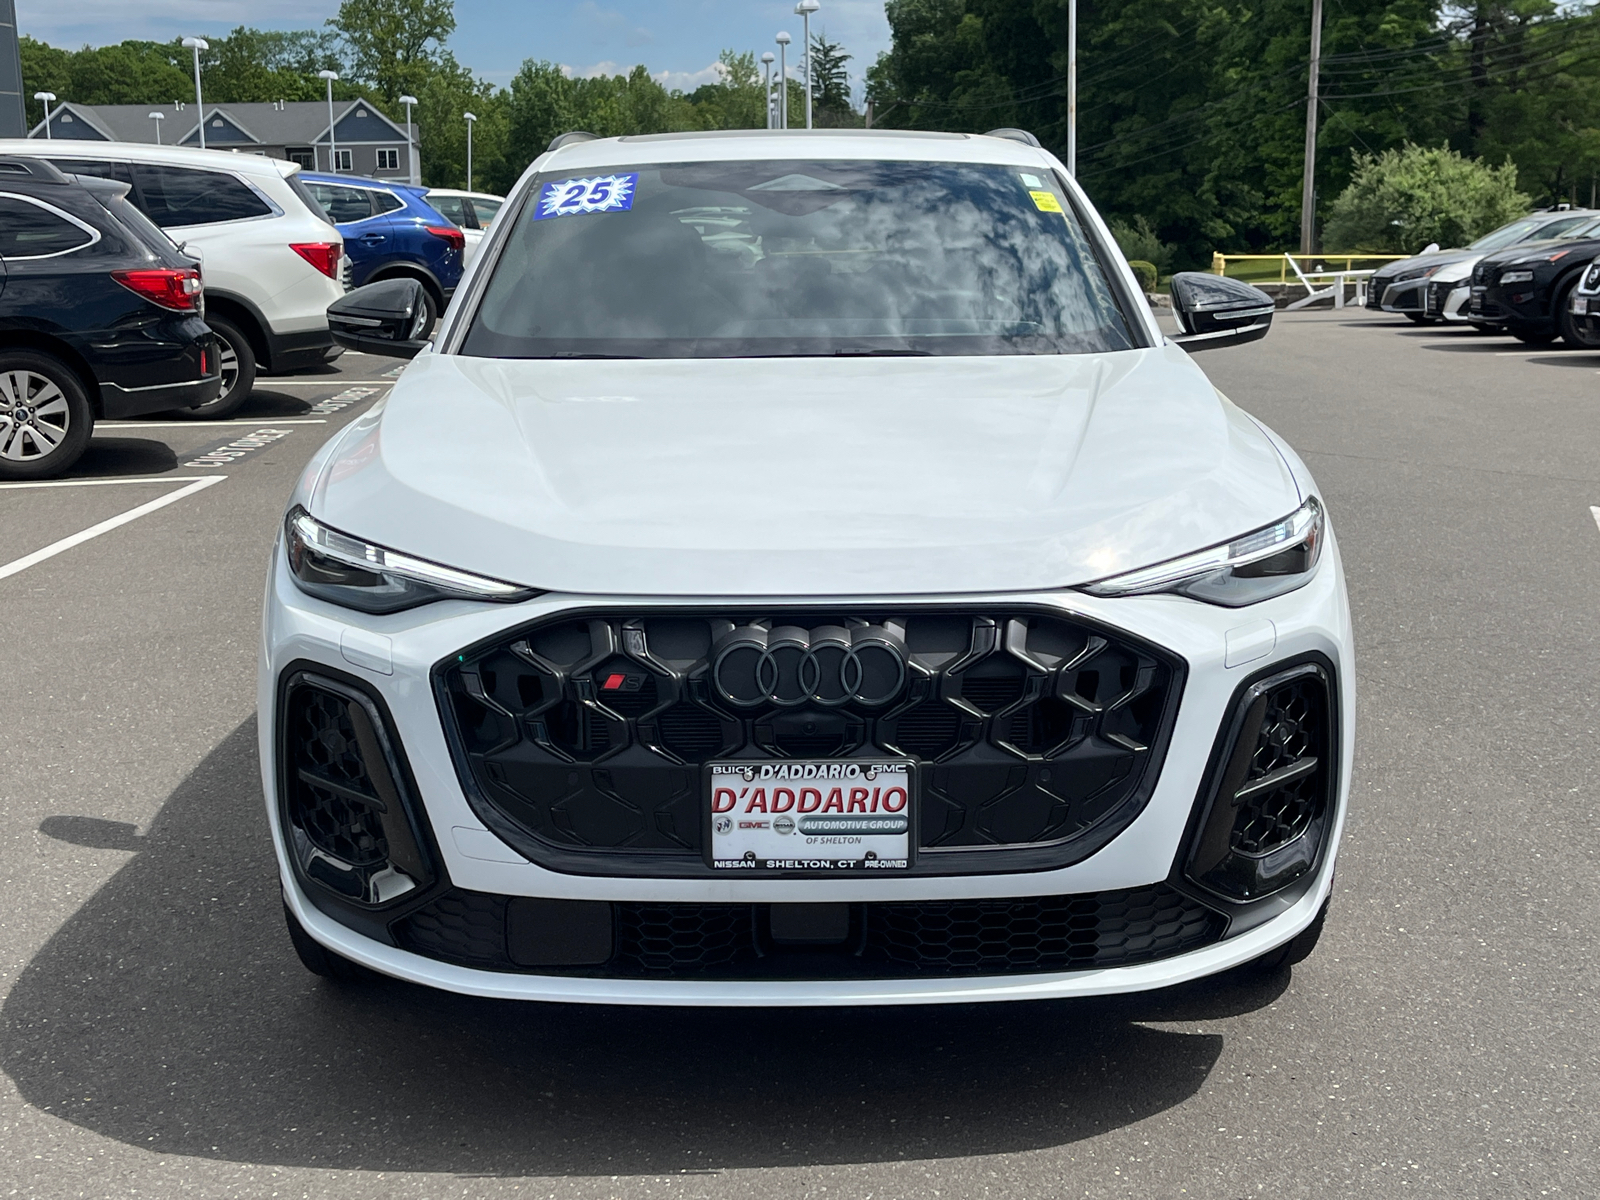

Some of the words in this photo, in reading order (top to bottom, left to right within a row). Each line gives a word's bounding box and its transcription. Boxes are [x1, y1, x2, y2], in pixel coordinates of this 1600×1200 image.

[559, 181, 612, 208] 25
[184, 428, 293, 467] CUSTOMER
[713, 766, 754, 774] BUICK
[760, 764, 861, 780] D'ADDARIO
[871, 764, 907, 773] GMC
[712, 786, 907, 814] D'ADDARIO
[739, 821, 770, 829] GMC
[804, 820, 868, 830] AUTOMOTIVE
[869, 820, 904, 829] GROUP
[806, 837, 819, 845] OF
[820, 836, 862, 845] SHELTON
[715, 860, 756, 868] NISSAN
[766, 860, 834, 869] SHELTON,
[837, 860, 857, 868] CT
[864, 860, 907, 868] PRE-OWNED
